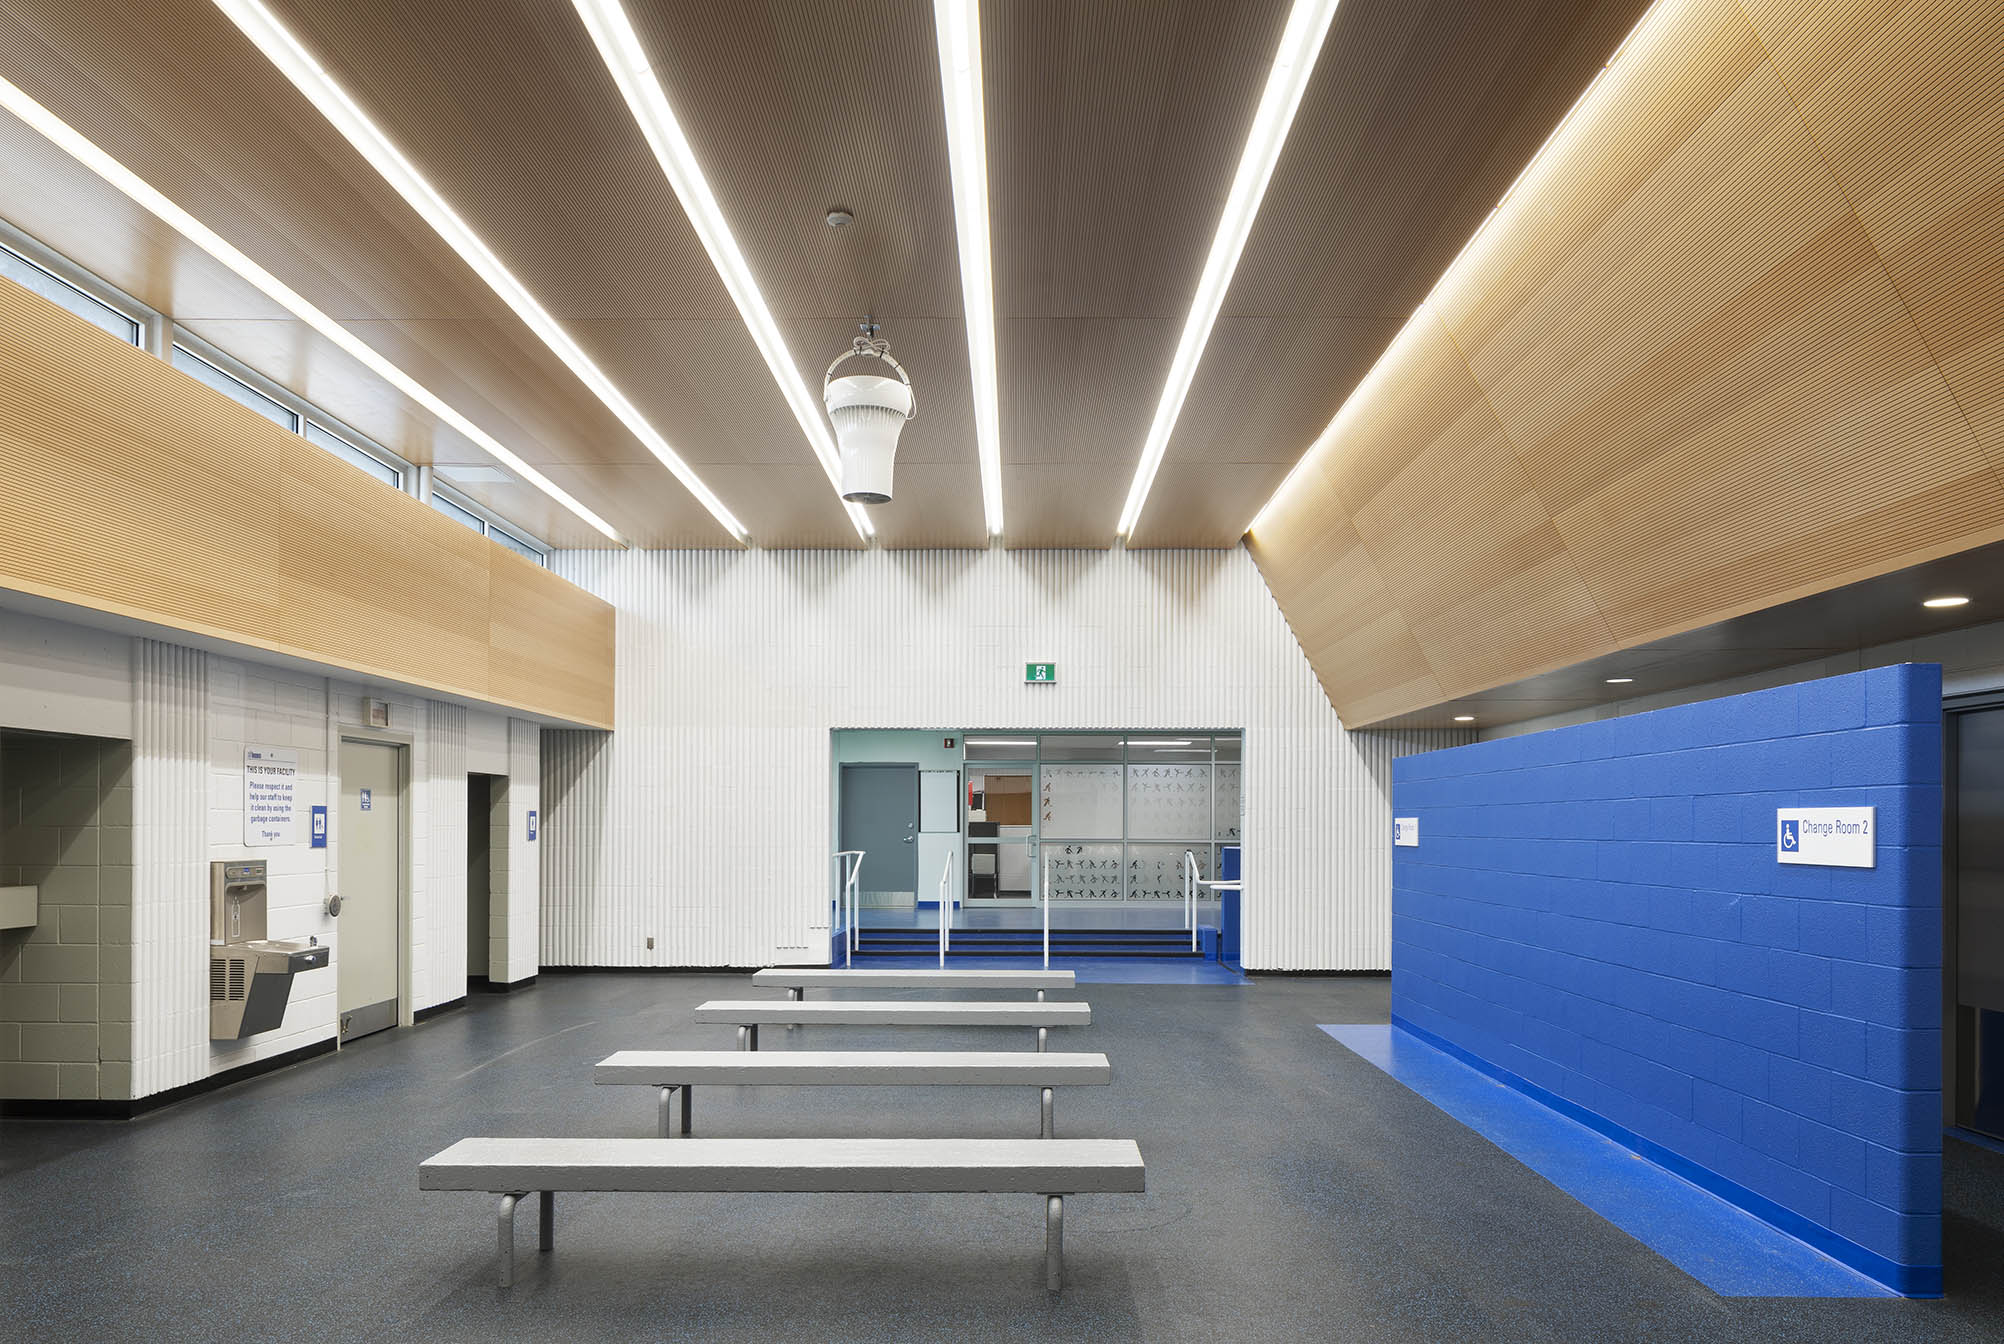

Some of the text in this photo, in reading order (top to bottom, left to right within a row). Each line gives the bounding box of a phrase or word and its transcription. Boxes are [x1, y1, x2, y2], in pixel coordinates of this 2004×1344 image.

[246, 765, 257, 774] THIS
[264, 766, 276, 776] YOUR
[277, 768, 296, 776] FACILITY
[249, 781, 264, 790] Please
[249, 792, 259, 801] help
[250, 816, 268, 824] garbage
[1802, 820, 1868, 837] Change Room 2
